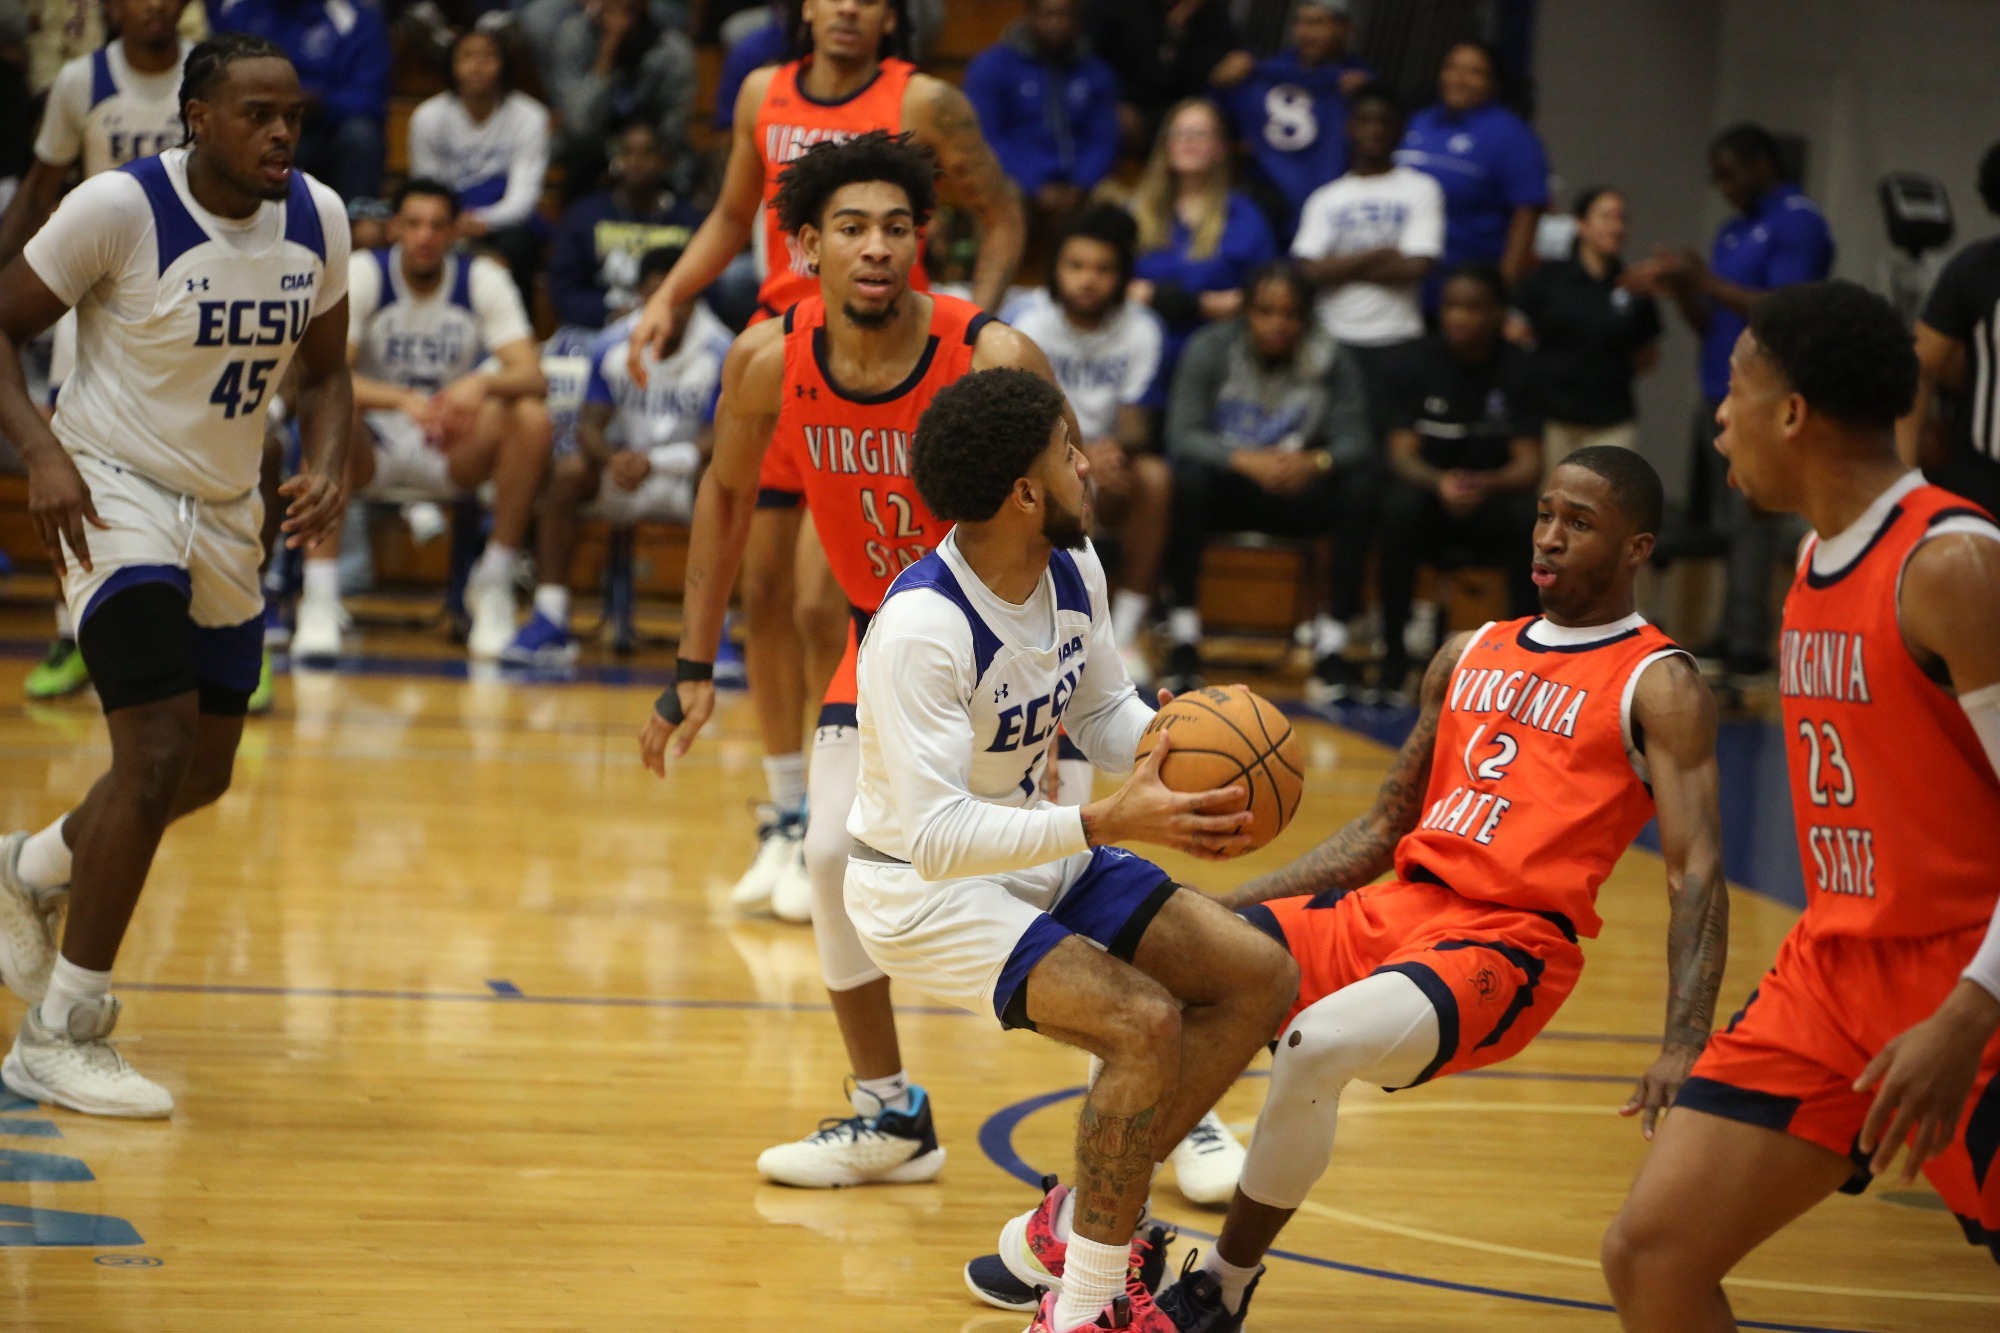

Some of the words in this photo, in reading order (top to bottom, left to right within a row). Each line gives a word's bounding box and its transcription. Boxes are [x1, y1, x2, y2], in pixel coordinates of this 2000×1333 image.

[1263, 82, 1319, 152] 8
[280, 272, 315, 291] CIAA
[193, 299, 310, 347] ECSU
[209, 358, 279, 420] 45
[803, 424, 917, 479] VIRGIN
[1058, 635, 1083, 667] IAA
[1450, 668, 1588, 738] VIRGINIA
[1799, 718, 1855, 807] 23
[1809, 826, 1876, 898] STATE
